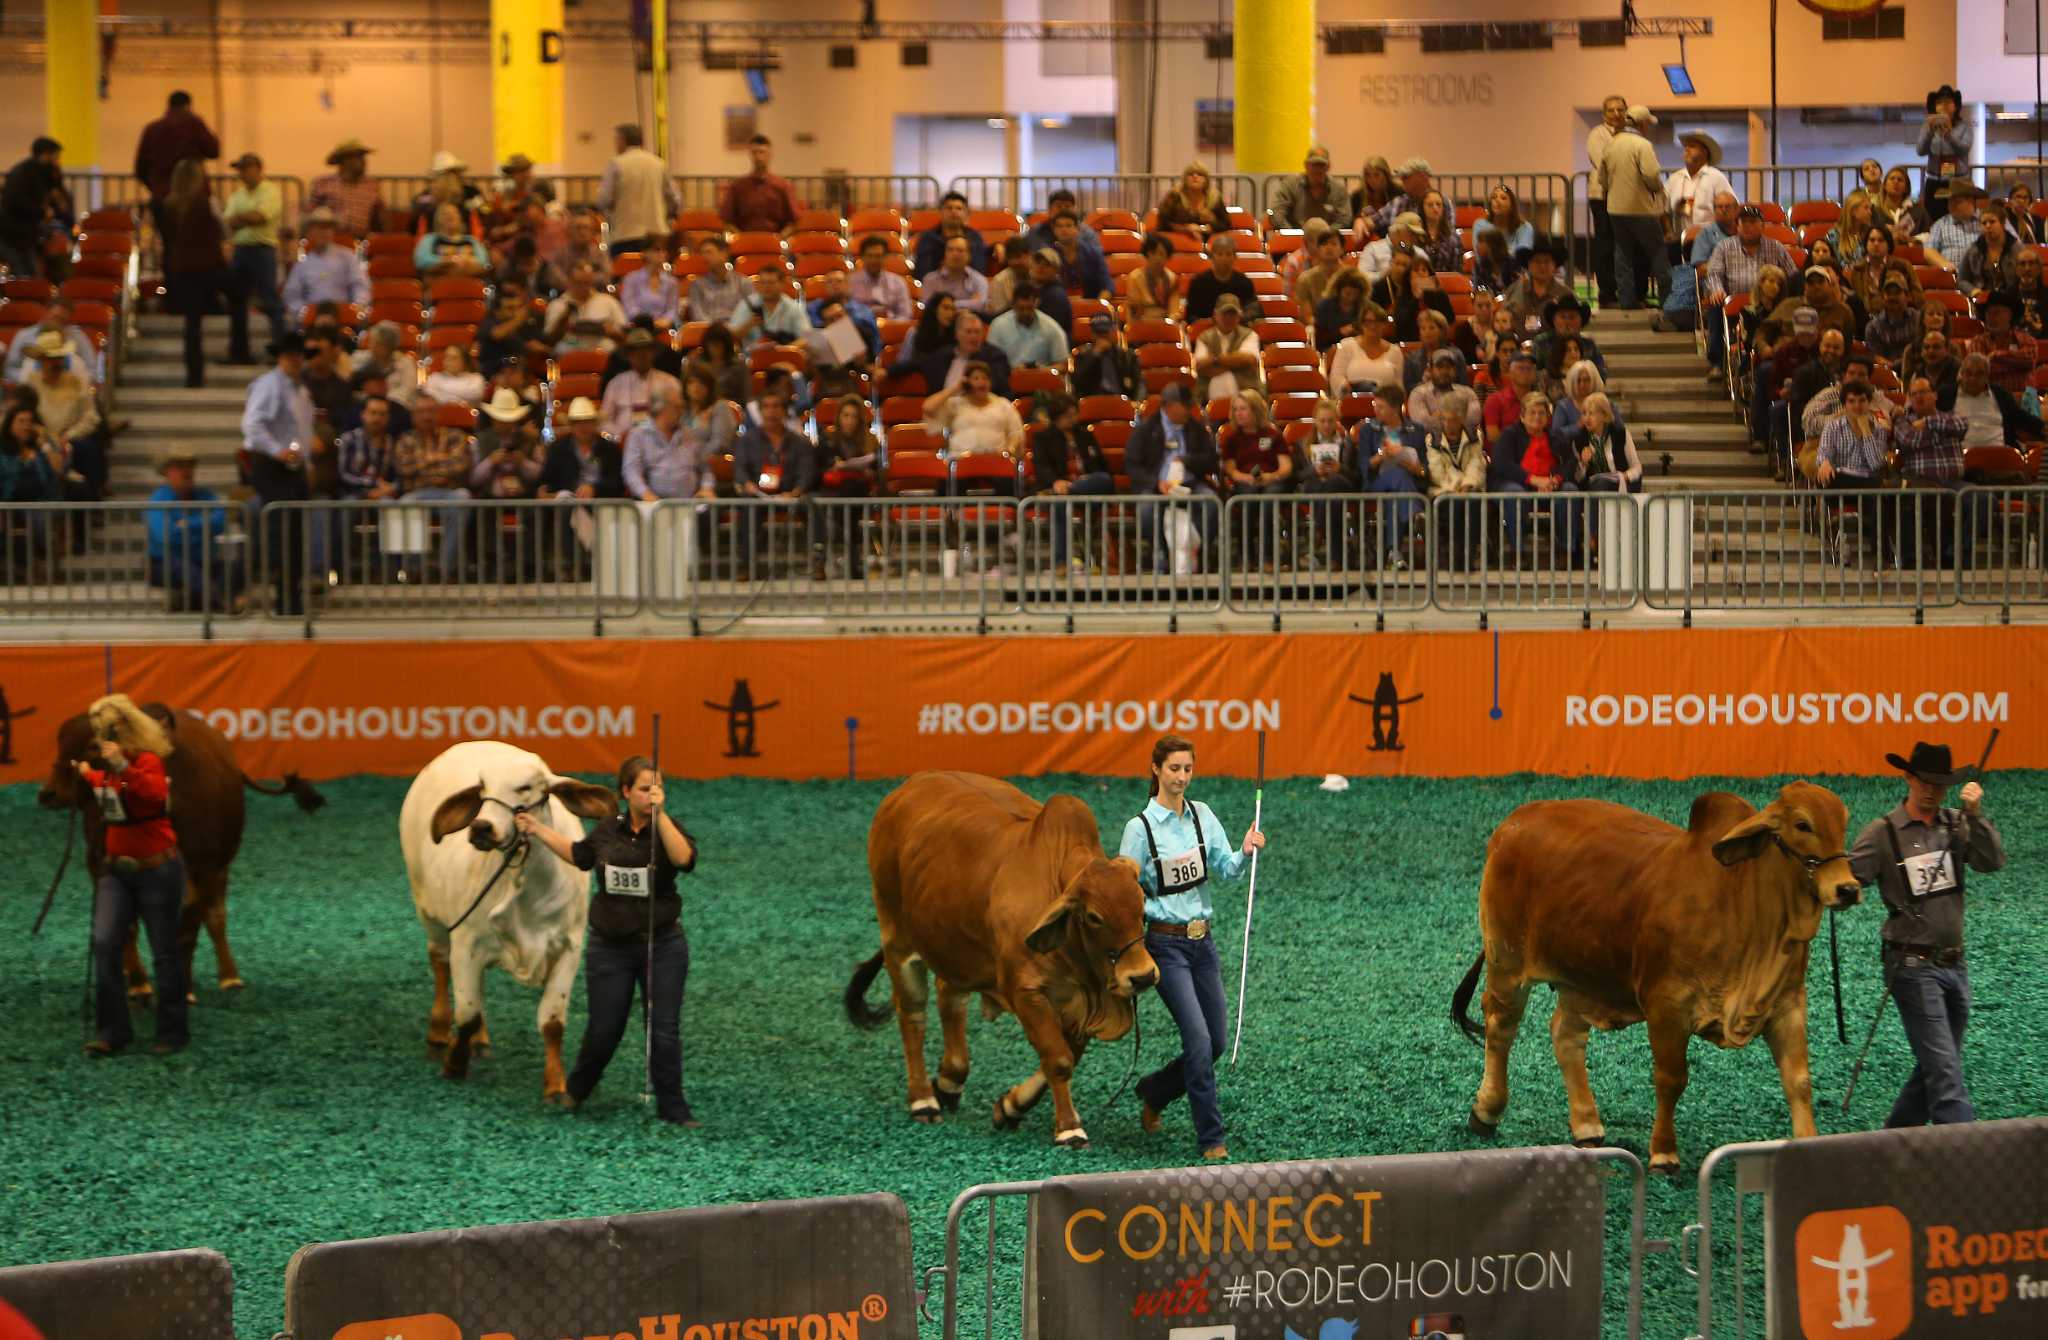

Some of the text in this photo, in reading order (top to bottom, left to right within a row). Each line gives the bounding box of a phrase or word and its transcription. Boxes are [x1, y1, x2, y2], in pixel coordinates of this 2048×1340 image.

[1359, 73, 1494, 105] RESTROOMS
[188, 706, 636, 739] ODEOHOUSTON.COM
[918, 699, 1280, 734] #RODEOHOUSTON
[1565, 692, 2009, 726] RODEOHOUSTON.COM
[611, 871, 640, 888] 388
[1171, 861, 1198, 884] 386
[1064, 1192, 1382, 1262] CONNECT
[1132, 1250, 1573, 1318] with #RODEOHOUSTON
[1926, 1273, 2009, 1316] app
